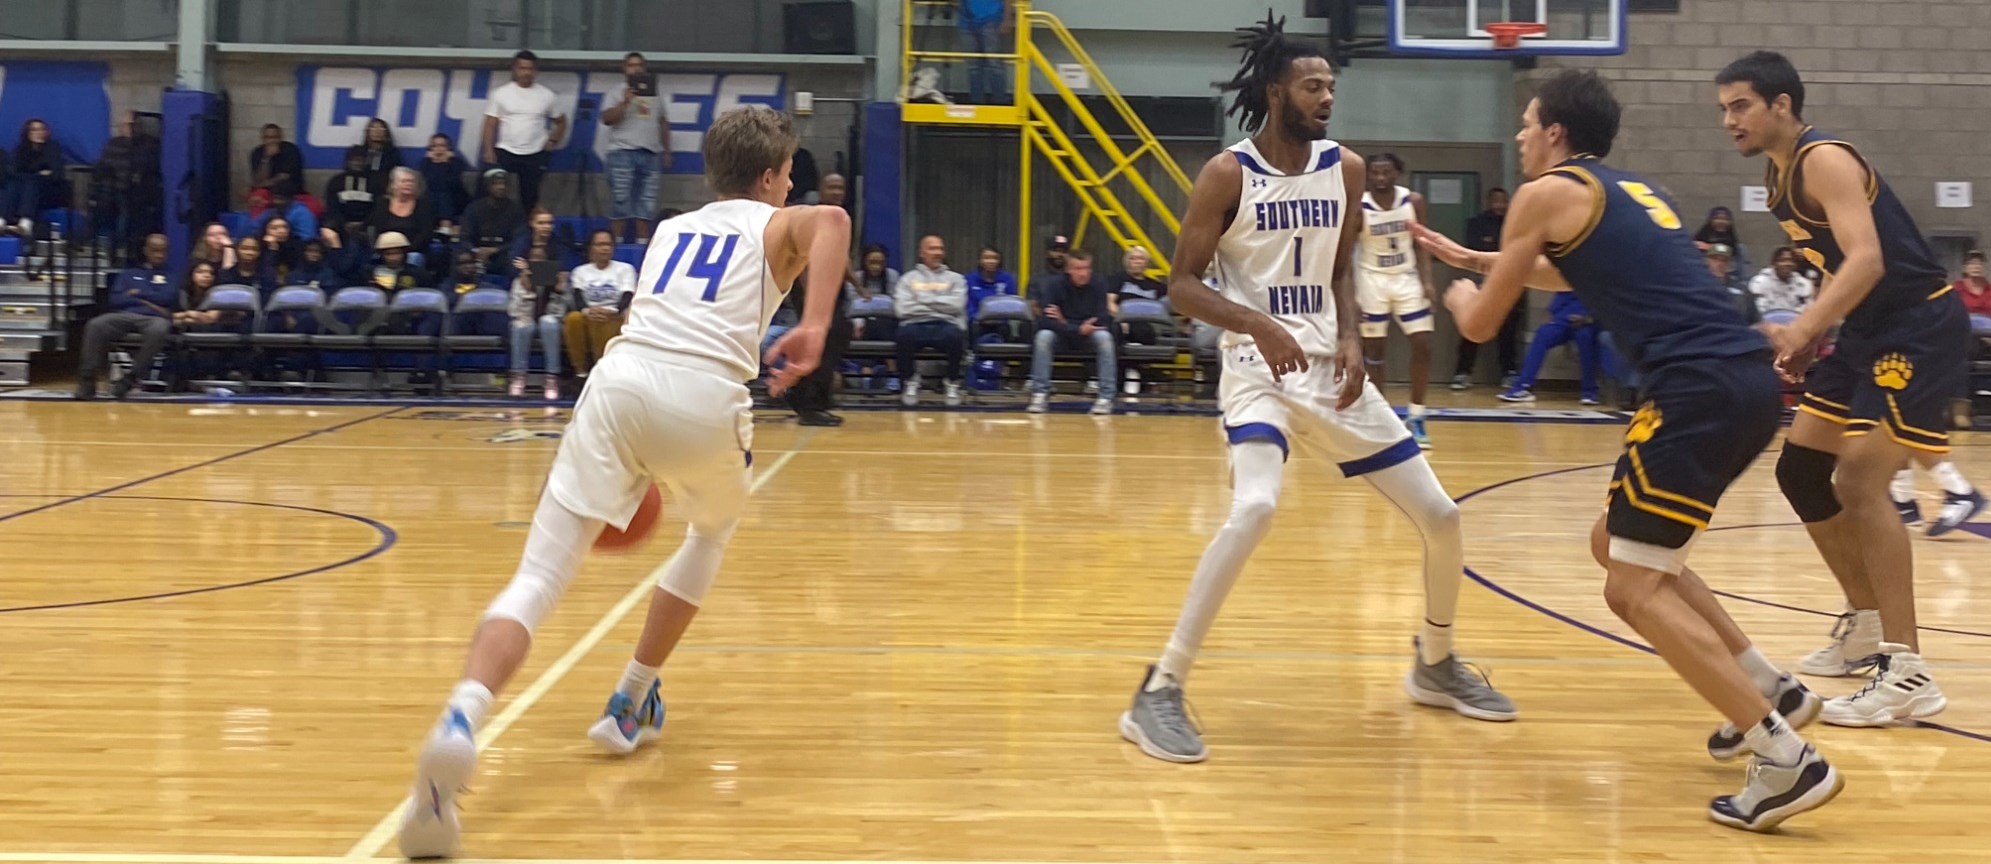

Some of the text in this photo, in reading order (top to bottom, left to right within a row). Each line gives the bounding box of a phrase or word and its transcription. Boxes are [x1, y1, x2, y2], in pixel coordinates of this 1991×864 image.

[1255, 199, 1338, 231] SOUTHERN
[1616, 180, 1682, 230] 5
[652, 233, 740, 302] 14
[1293, 236, 1303, 277] 1
